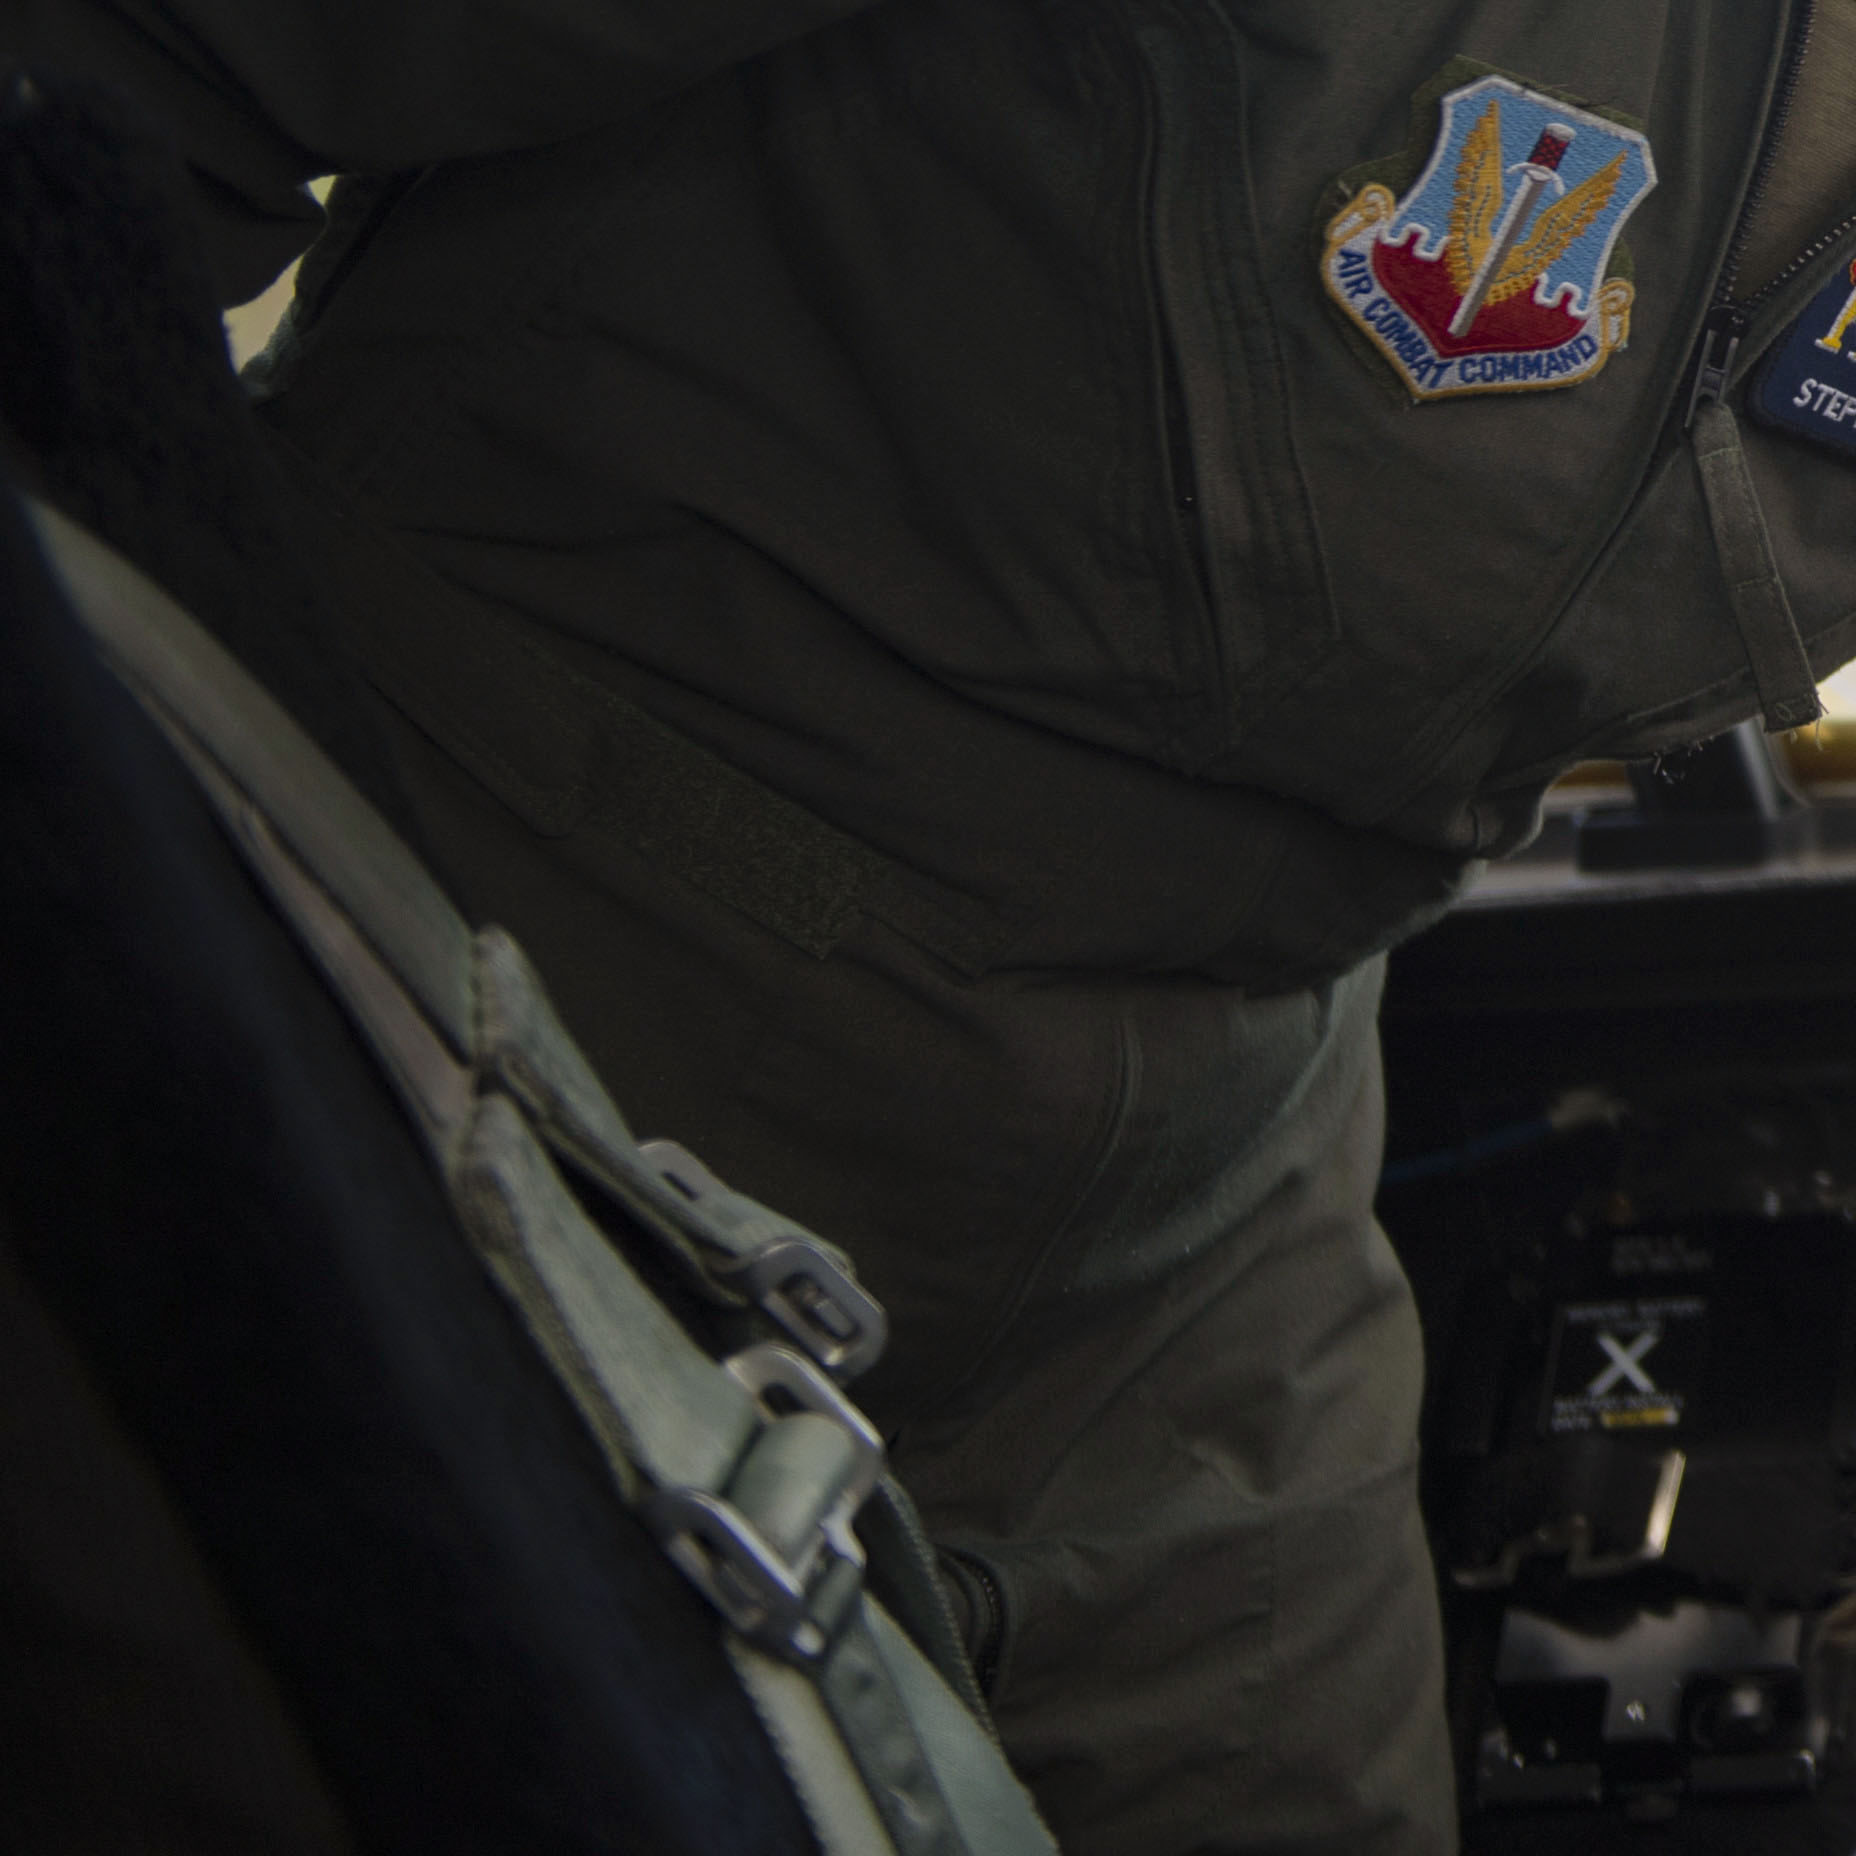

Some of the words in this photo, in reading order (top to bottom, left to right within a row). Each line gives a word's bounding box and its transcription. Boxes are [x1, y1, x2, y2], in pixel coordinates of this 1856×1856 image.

[1338, 248, 1374, 299] AIR
[1362, 297, 1453, 389] COMBAT
[1459, 334, 1598, 384] COMMAND
